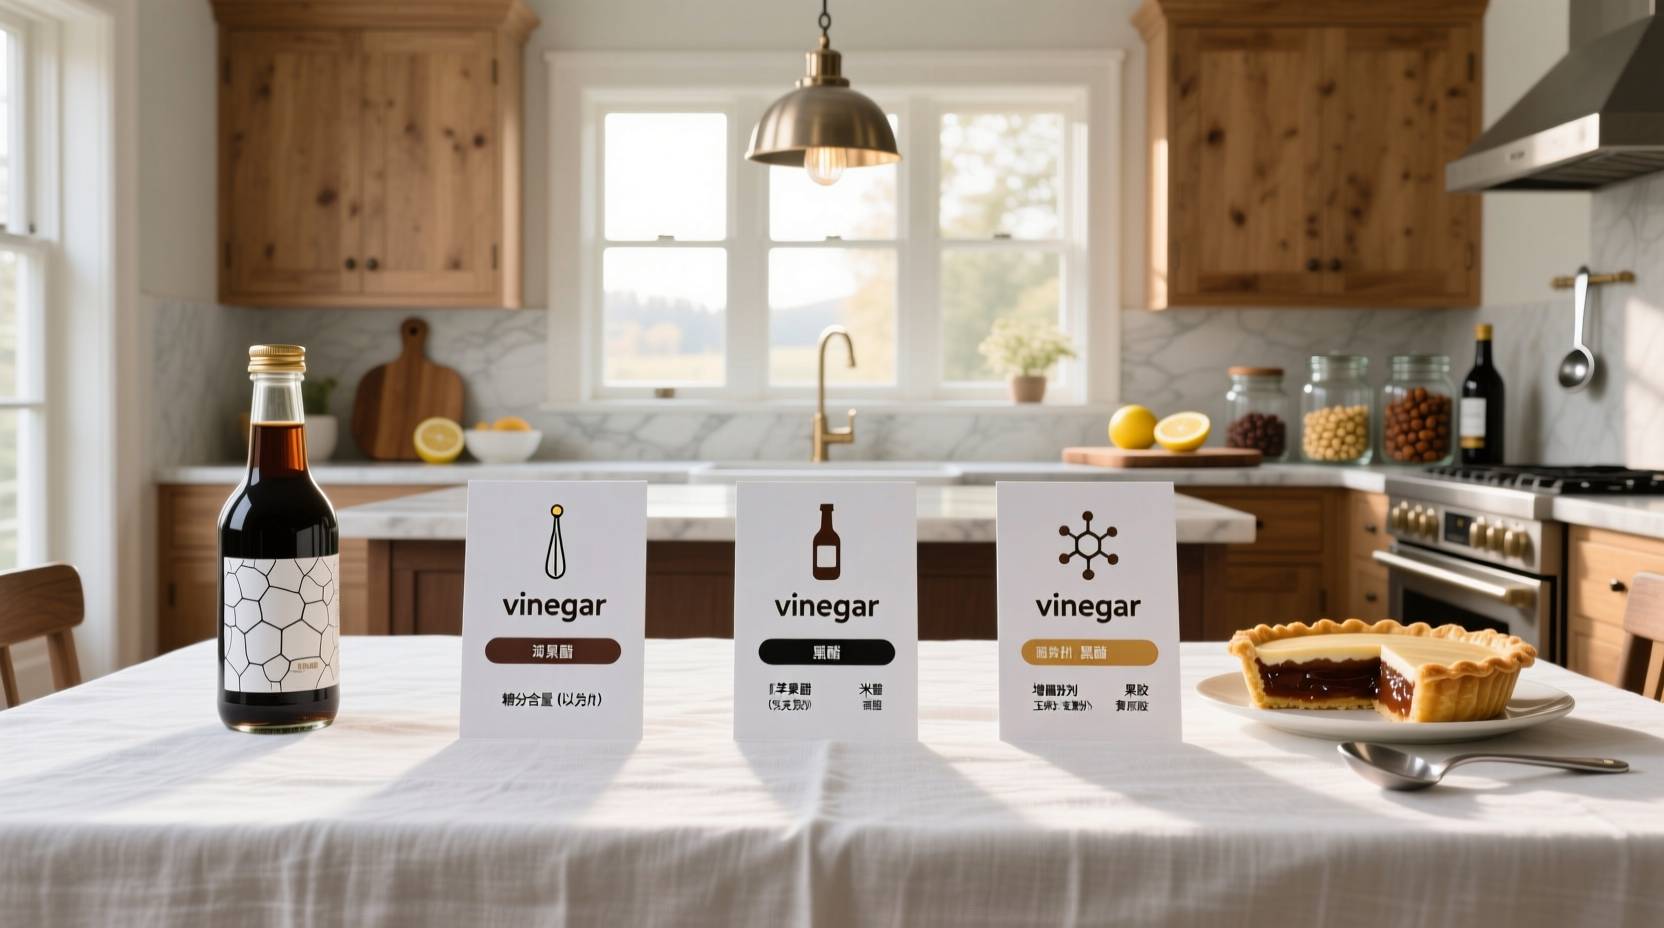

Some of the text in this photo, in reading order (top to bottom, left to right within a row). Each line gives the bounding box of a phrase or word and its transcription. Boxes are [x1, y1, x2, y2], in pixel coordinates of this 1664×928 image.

[502, 591, 607, 623] vinegar
[774, 592, 880, 624] vinegar
[1035, 592, 1141, 624] vinegar
